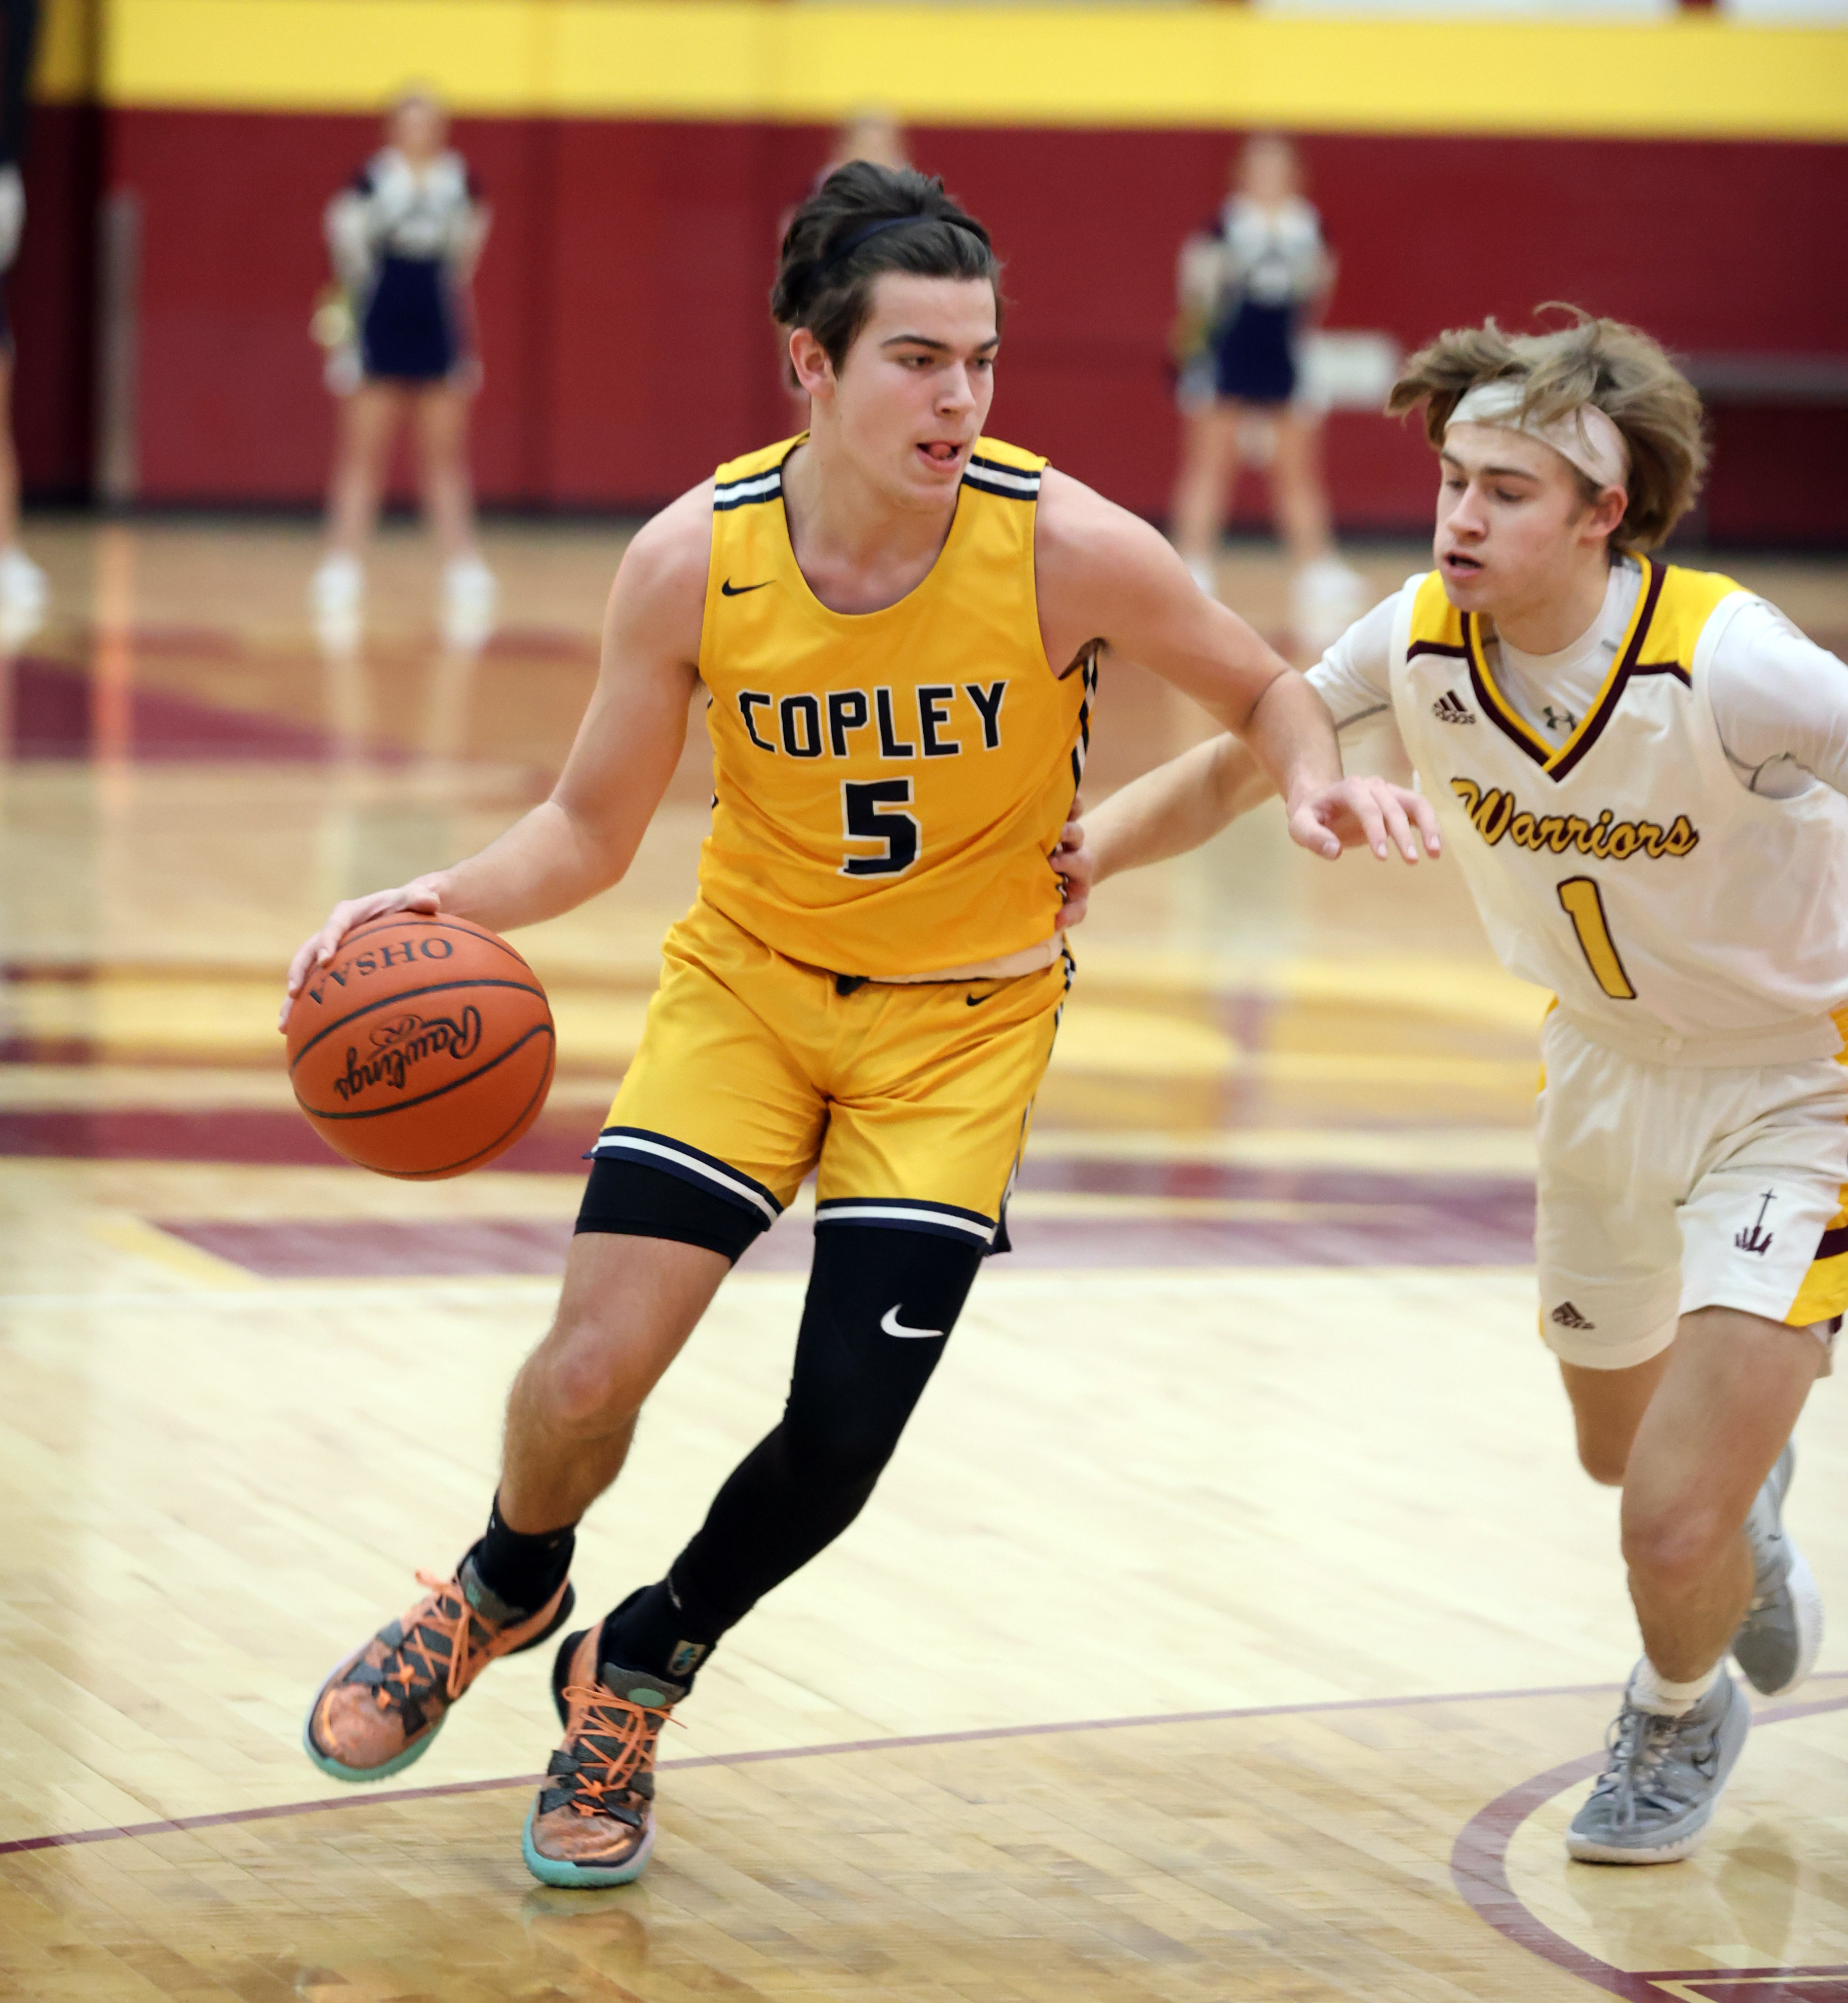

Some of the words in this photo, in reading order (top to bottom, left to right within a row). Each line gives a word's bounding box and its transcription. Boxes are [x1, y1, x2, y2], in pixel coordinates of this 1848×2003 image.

[737, 679, 1010, 759] COPLEY
[837, 775, 922, 879] 5
[1450, 777, 1699, 860] Warriors
[310, 937, 453, 1004] OHSAA
[1557, 876, 1637, 999] 1
[334, 1005, 482, 1101] Rawlings
